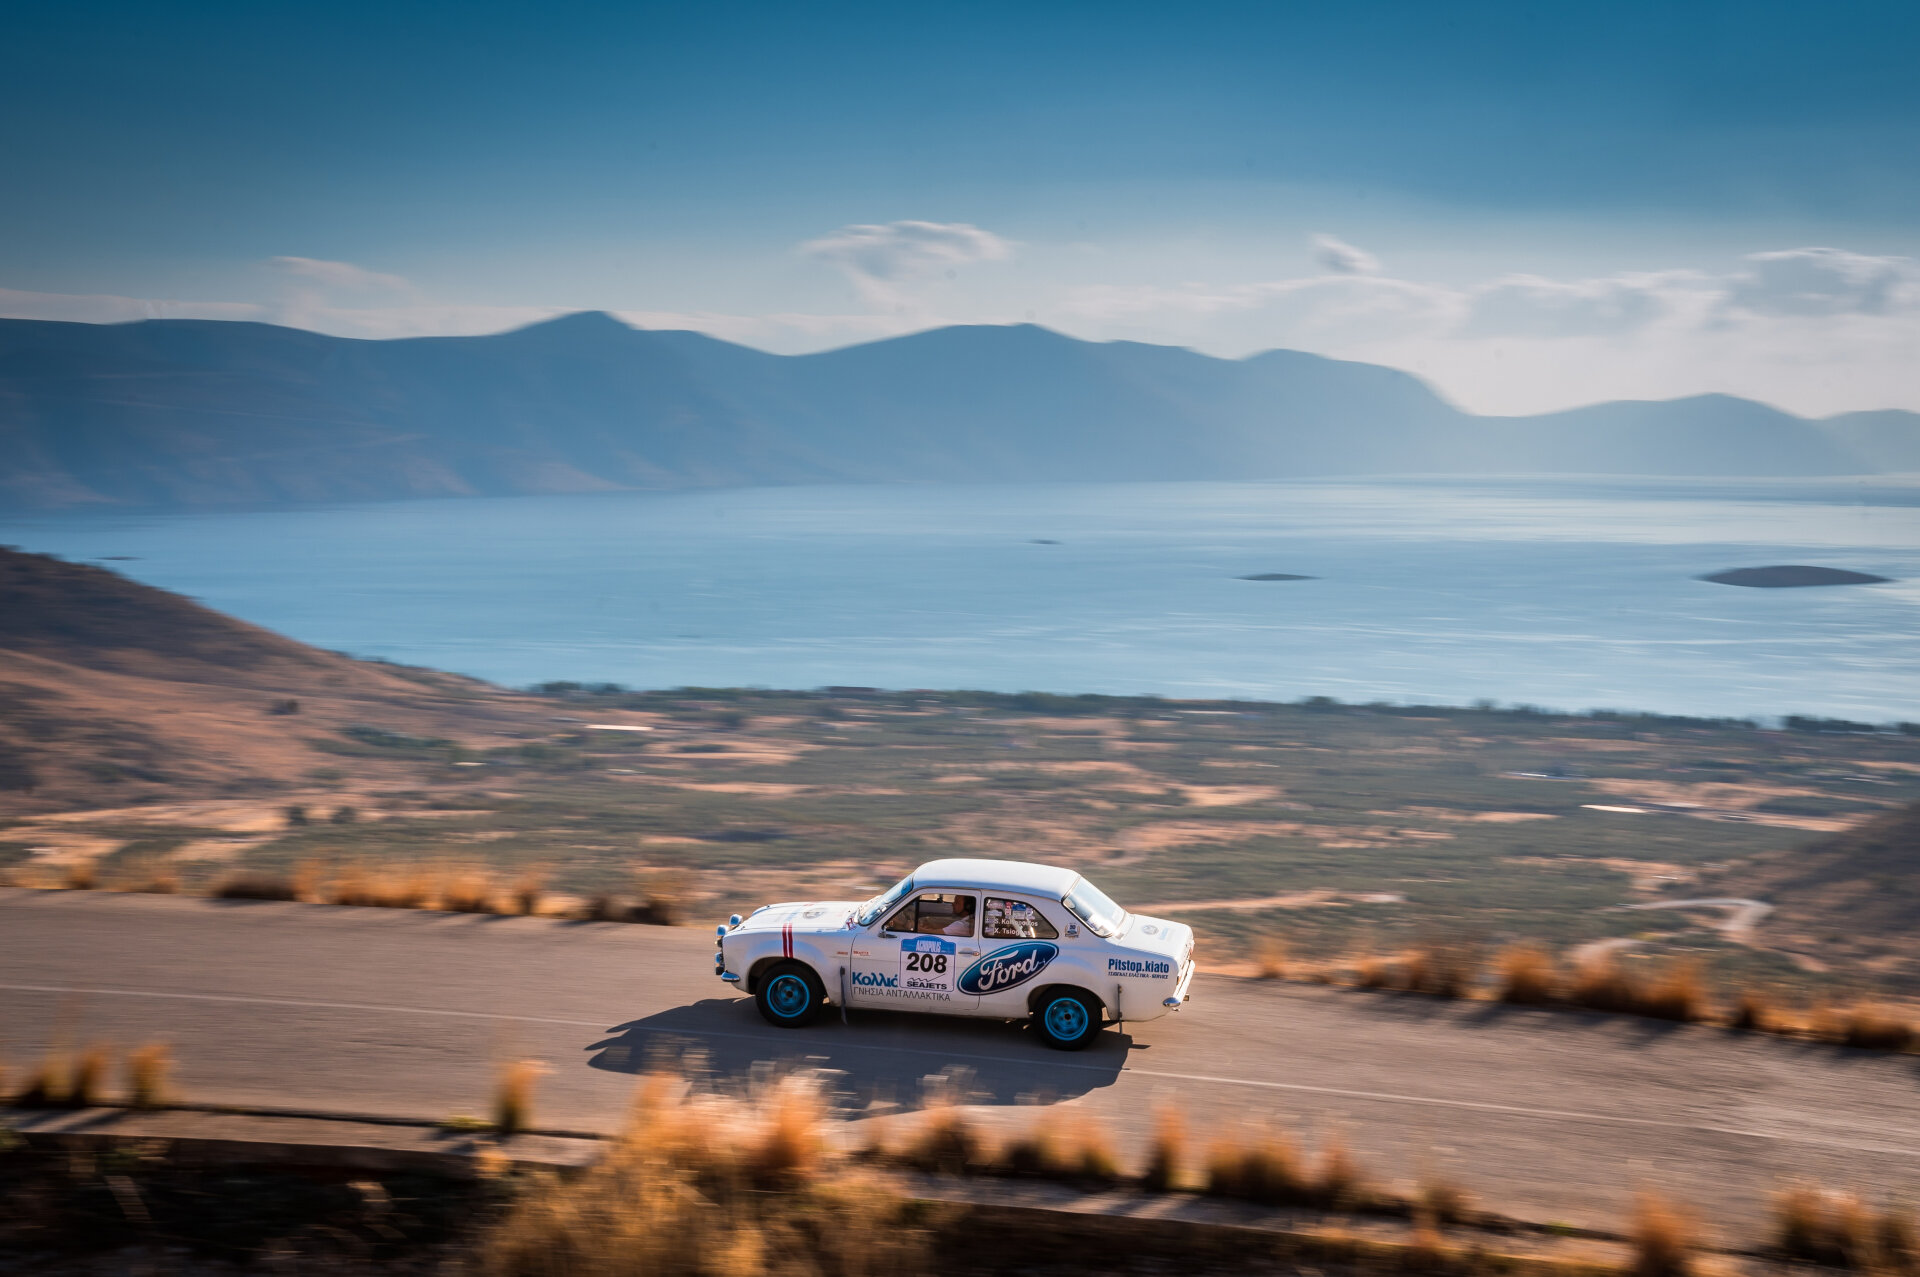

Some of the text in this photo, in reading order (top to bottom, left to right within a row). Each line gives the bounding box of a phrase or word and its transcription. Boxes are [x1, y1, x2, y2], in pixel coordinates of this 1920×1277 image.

[906, 952, 947, 974] 208
[977, 949, 1046, 990] Ford
[1108, 958, 1169, 973] Pitstop.kiato
[907, 980, 947, 990] SEAJETS
[853, 986, 951, 1002] ΓΝΗΣΙΑ ΑΝΤΑΛΛΑΚΤΙΚΑ
